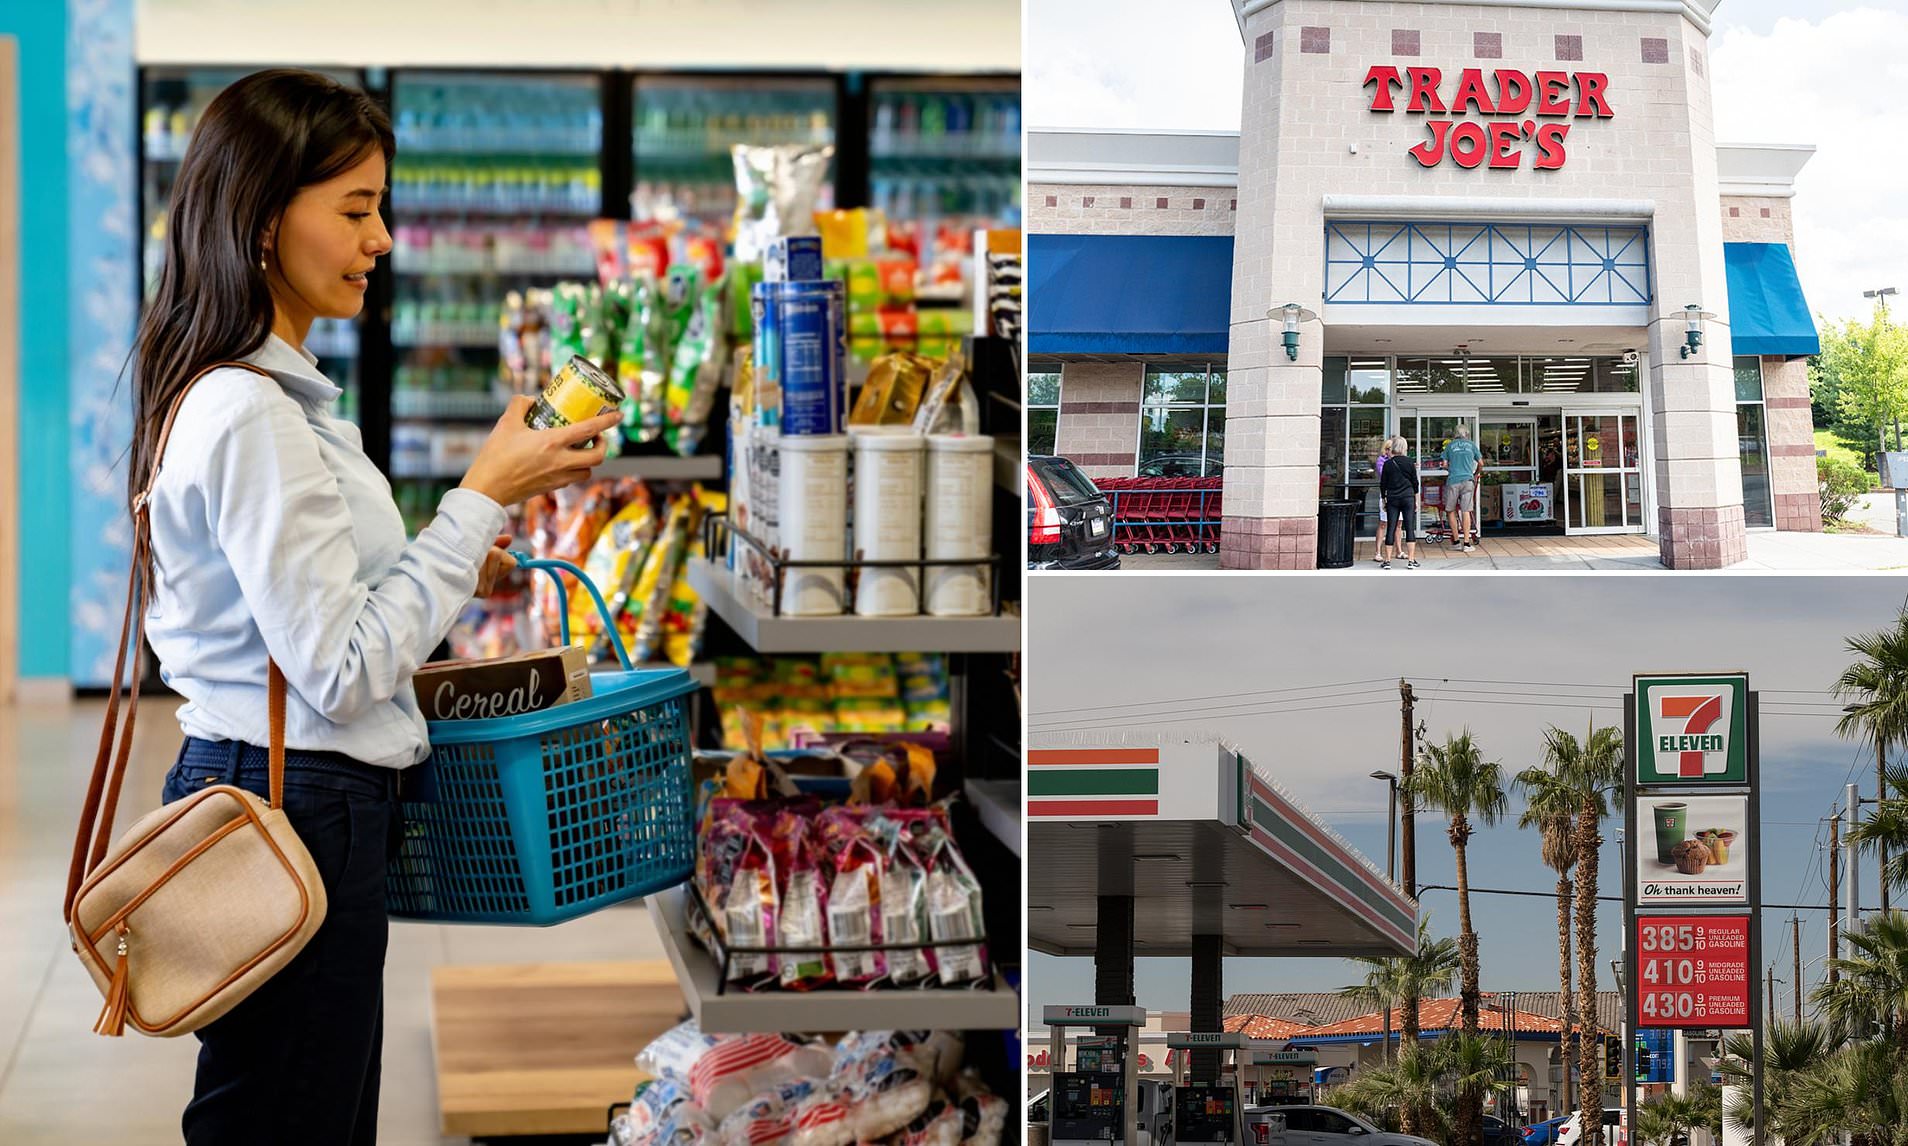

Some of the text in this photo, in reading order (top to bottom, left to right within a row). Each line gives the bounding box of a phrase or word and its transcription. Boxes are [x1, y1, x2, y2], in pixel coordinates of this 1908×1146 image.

[1363, 65, 1614, 118] TRADER
[1408, 119, 1571, 170] JOE'S
[434, 668, 543, 720] Cereal
[1661, 695, 1722, 777] 7
[1644, 884, 1742, 895] Oh thank heaven!
[1643, 926, 1693, 951] 385
[1643, 960, 1693, 984] 410
[1643, 993, 1693, 1018] 430
